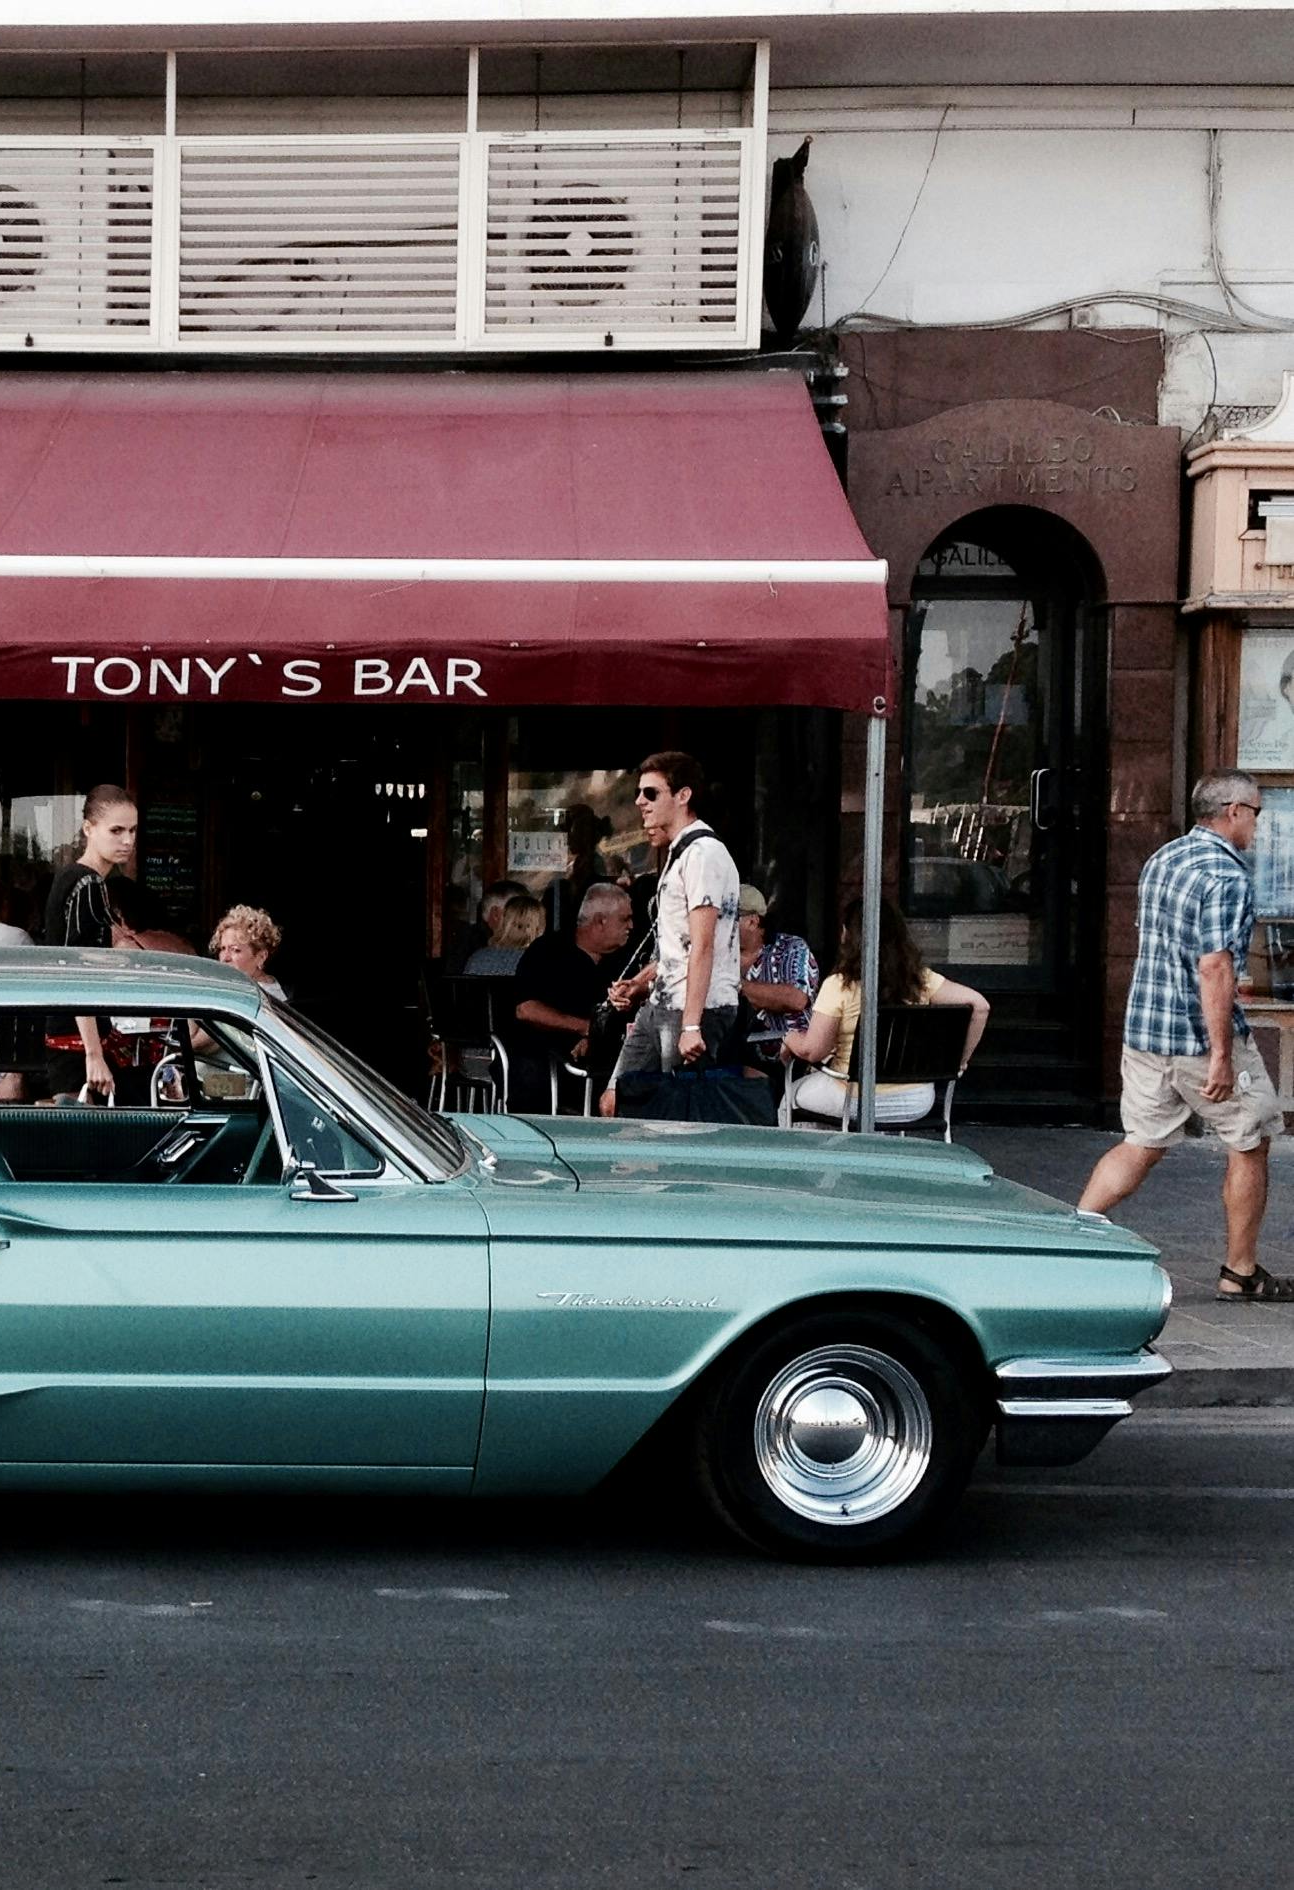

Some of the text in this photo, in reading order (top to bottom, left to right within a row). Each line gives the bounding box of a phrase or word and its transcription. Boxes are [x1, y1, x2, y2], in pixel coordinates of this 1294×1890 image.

[932, 434, 1094, 464] GALILEO
[885, 465, 1138, 496] APARTMENTS
[353, 656, 488, 697] BAR
[537, 1292, 720, 1308] Thunderbird
